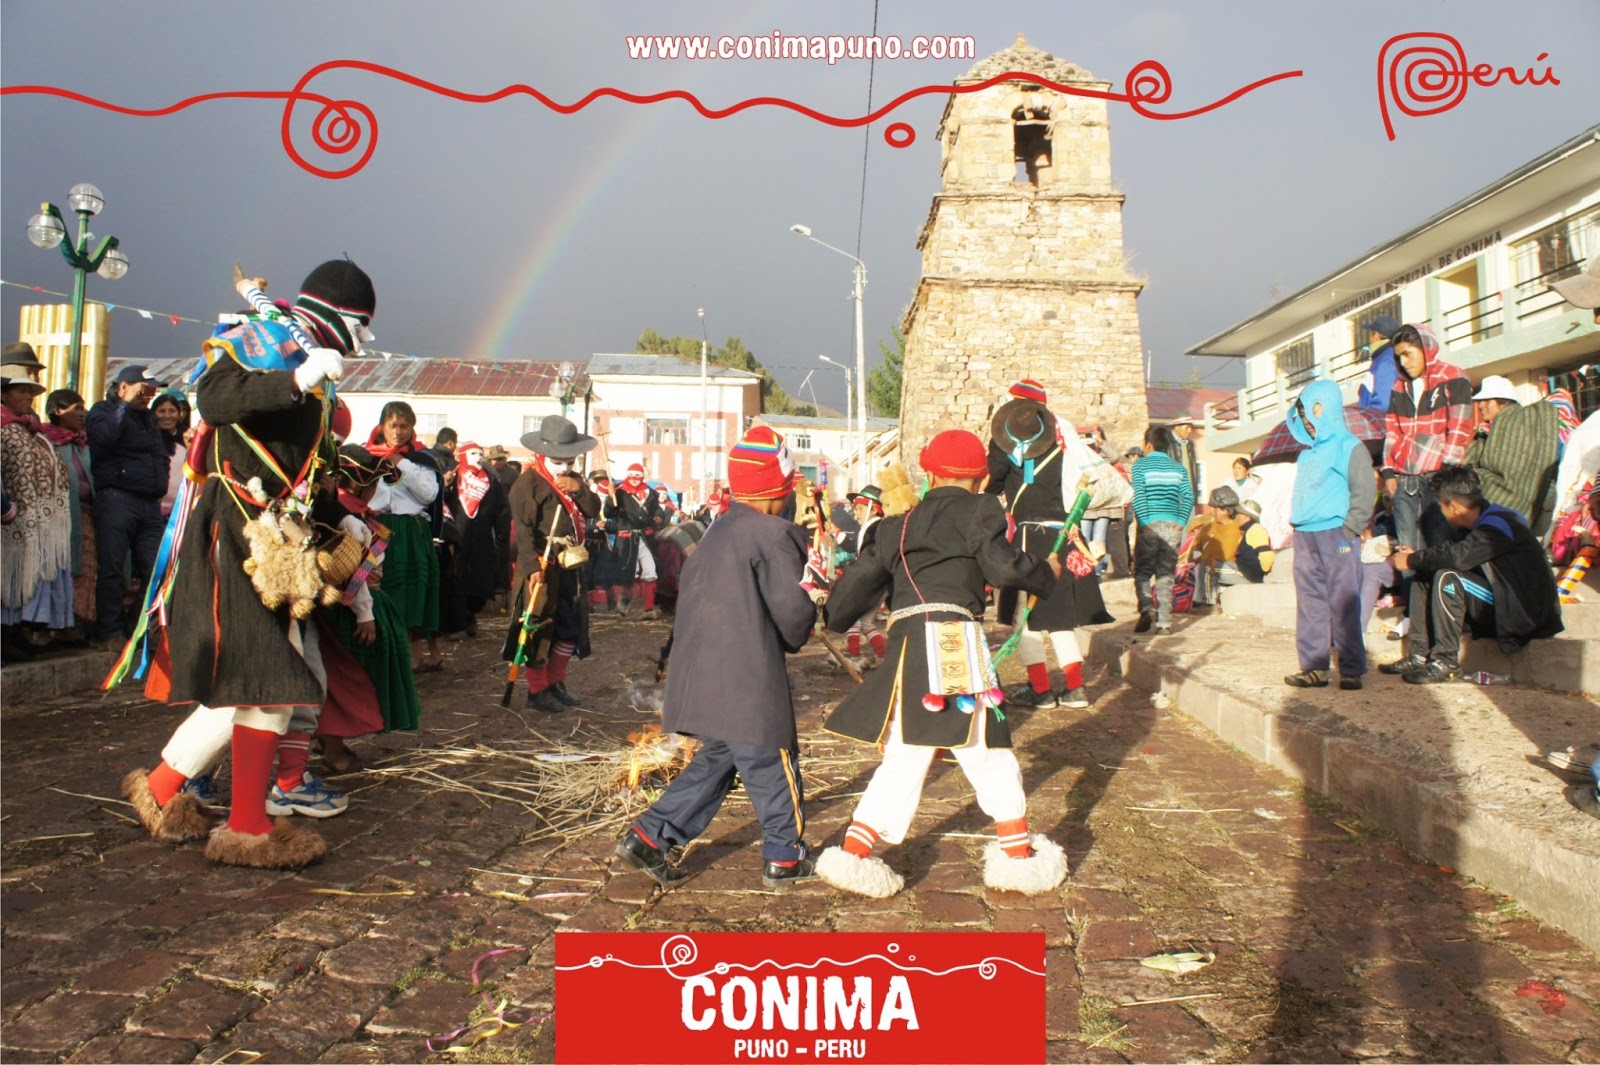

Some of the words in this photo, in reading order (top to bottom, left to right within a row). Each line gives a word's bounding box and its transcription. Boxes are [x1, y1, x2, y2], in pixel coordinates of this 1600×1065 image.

[1324, 287, 1382, 323] MUNICIPALIDAD
[1438, 253, 1452, 269] DE
[1456, 231, 1502, 260] CONIMA
